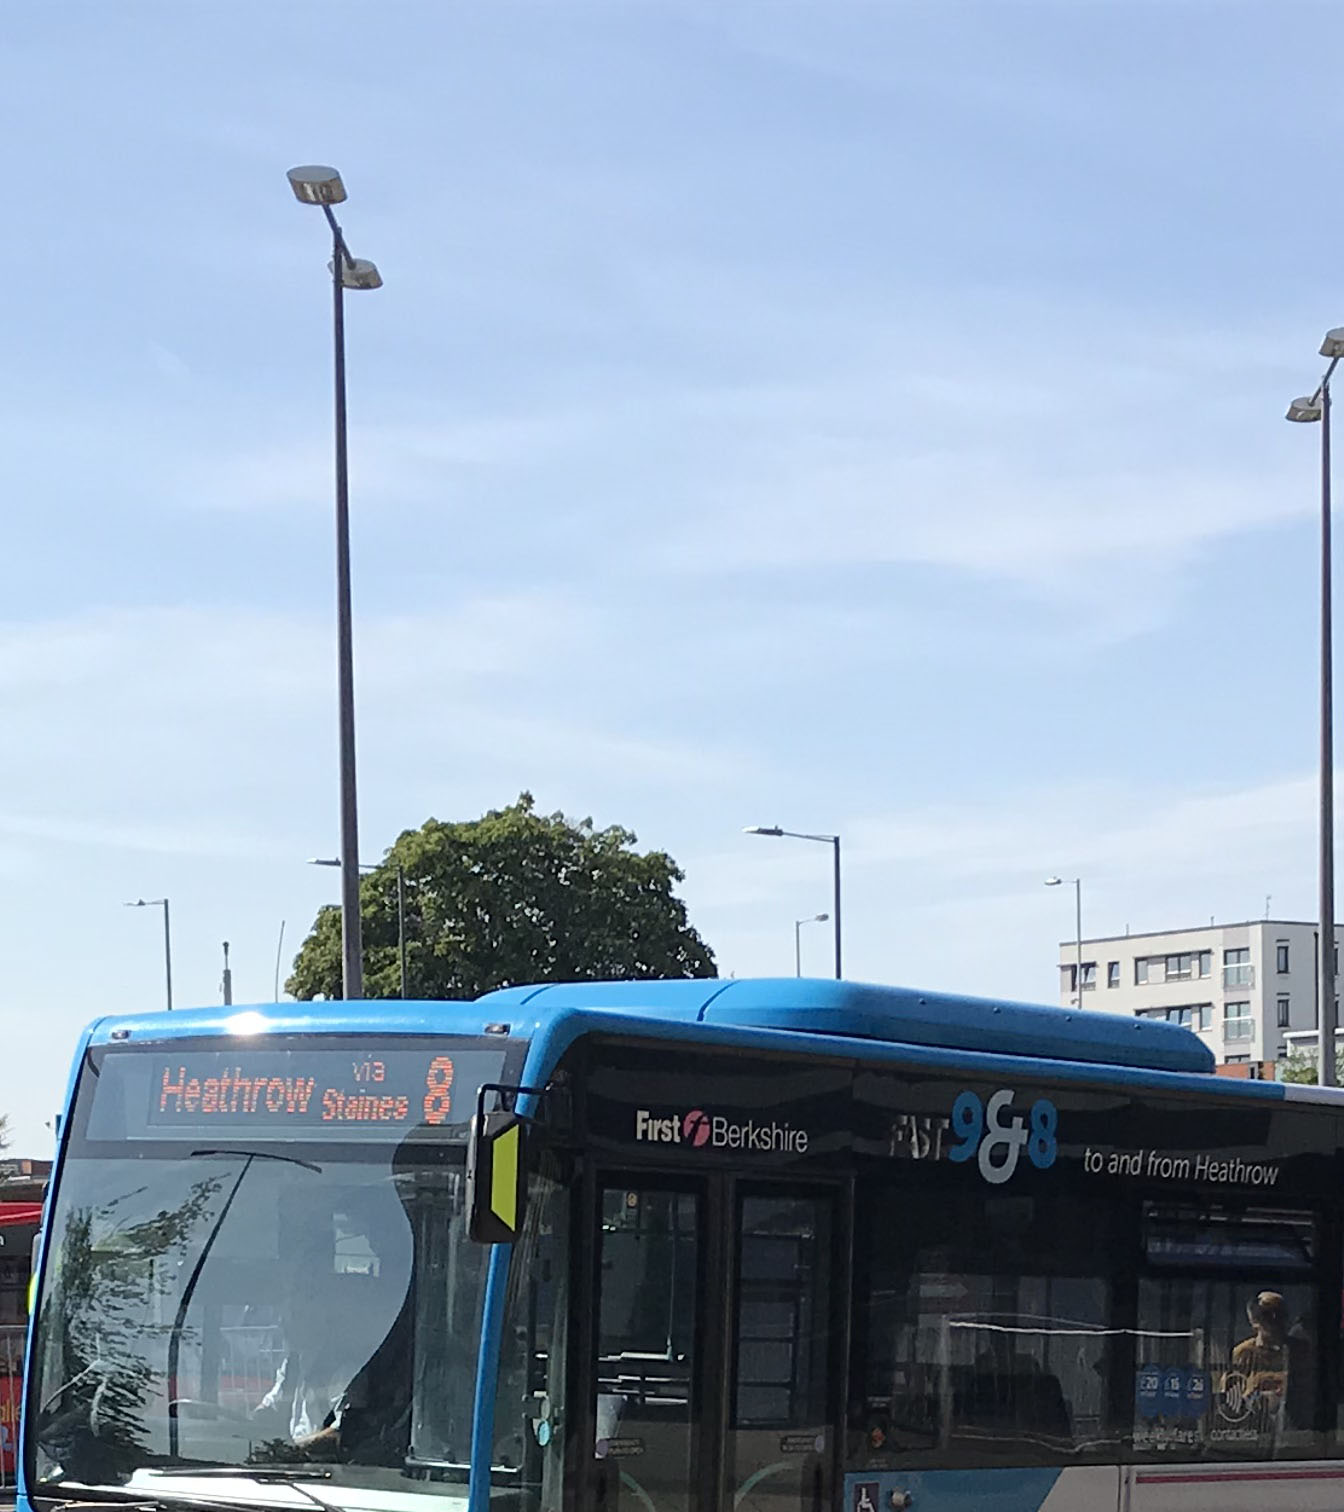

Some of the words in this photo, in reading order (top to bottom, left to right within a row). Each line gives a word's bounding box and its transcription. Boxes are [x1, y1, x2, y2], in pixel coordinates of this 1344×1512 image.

[159, 1066, 316, 1113] Heathrow
[322, 1088, 409, 1121] Staines
[423, 1056, 454, 1125] 8
[636, 1110, 681, 1143] First
[712, 1116, 808, 1153] Berkshire
[1083, 1147, 1104, 1173] to
[1108, 1149, 1144, 1176] and
[1147, 1150, 1190, 1179] from
[1194, 1154, 1280, 1185] Heathrow
